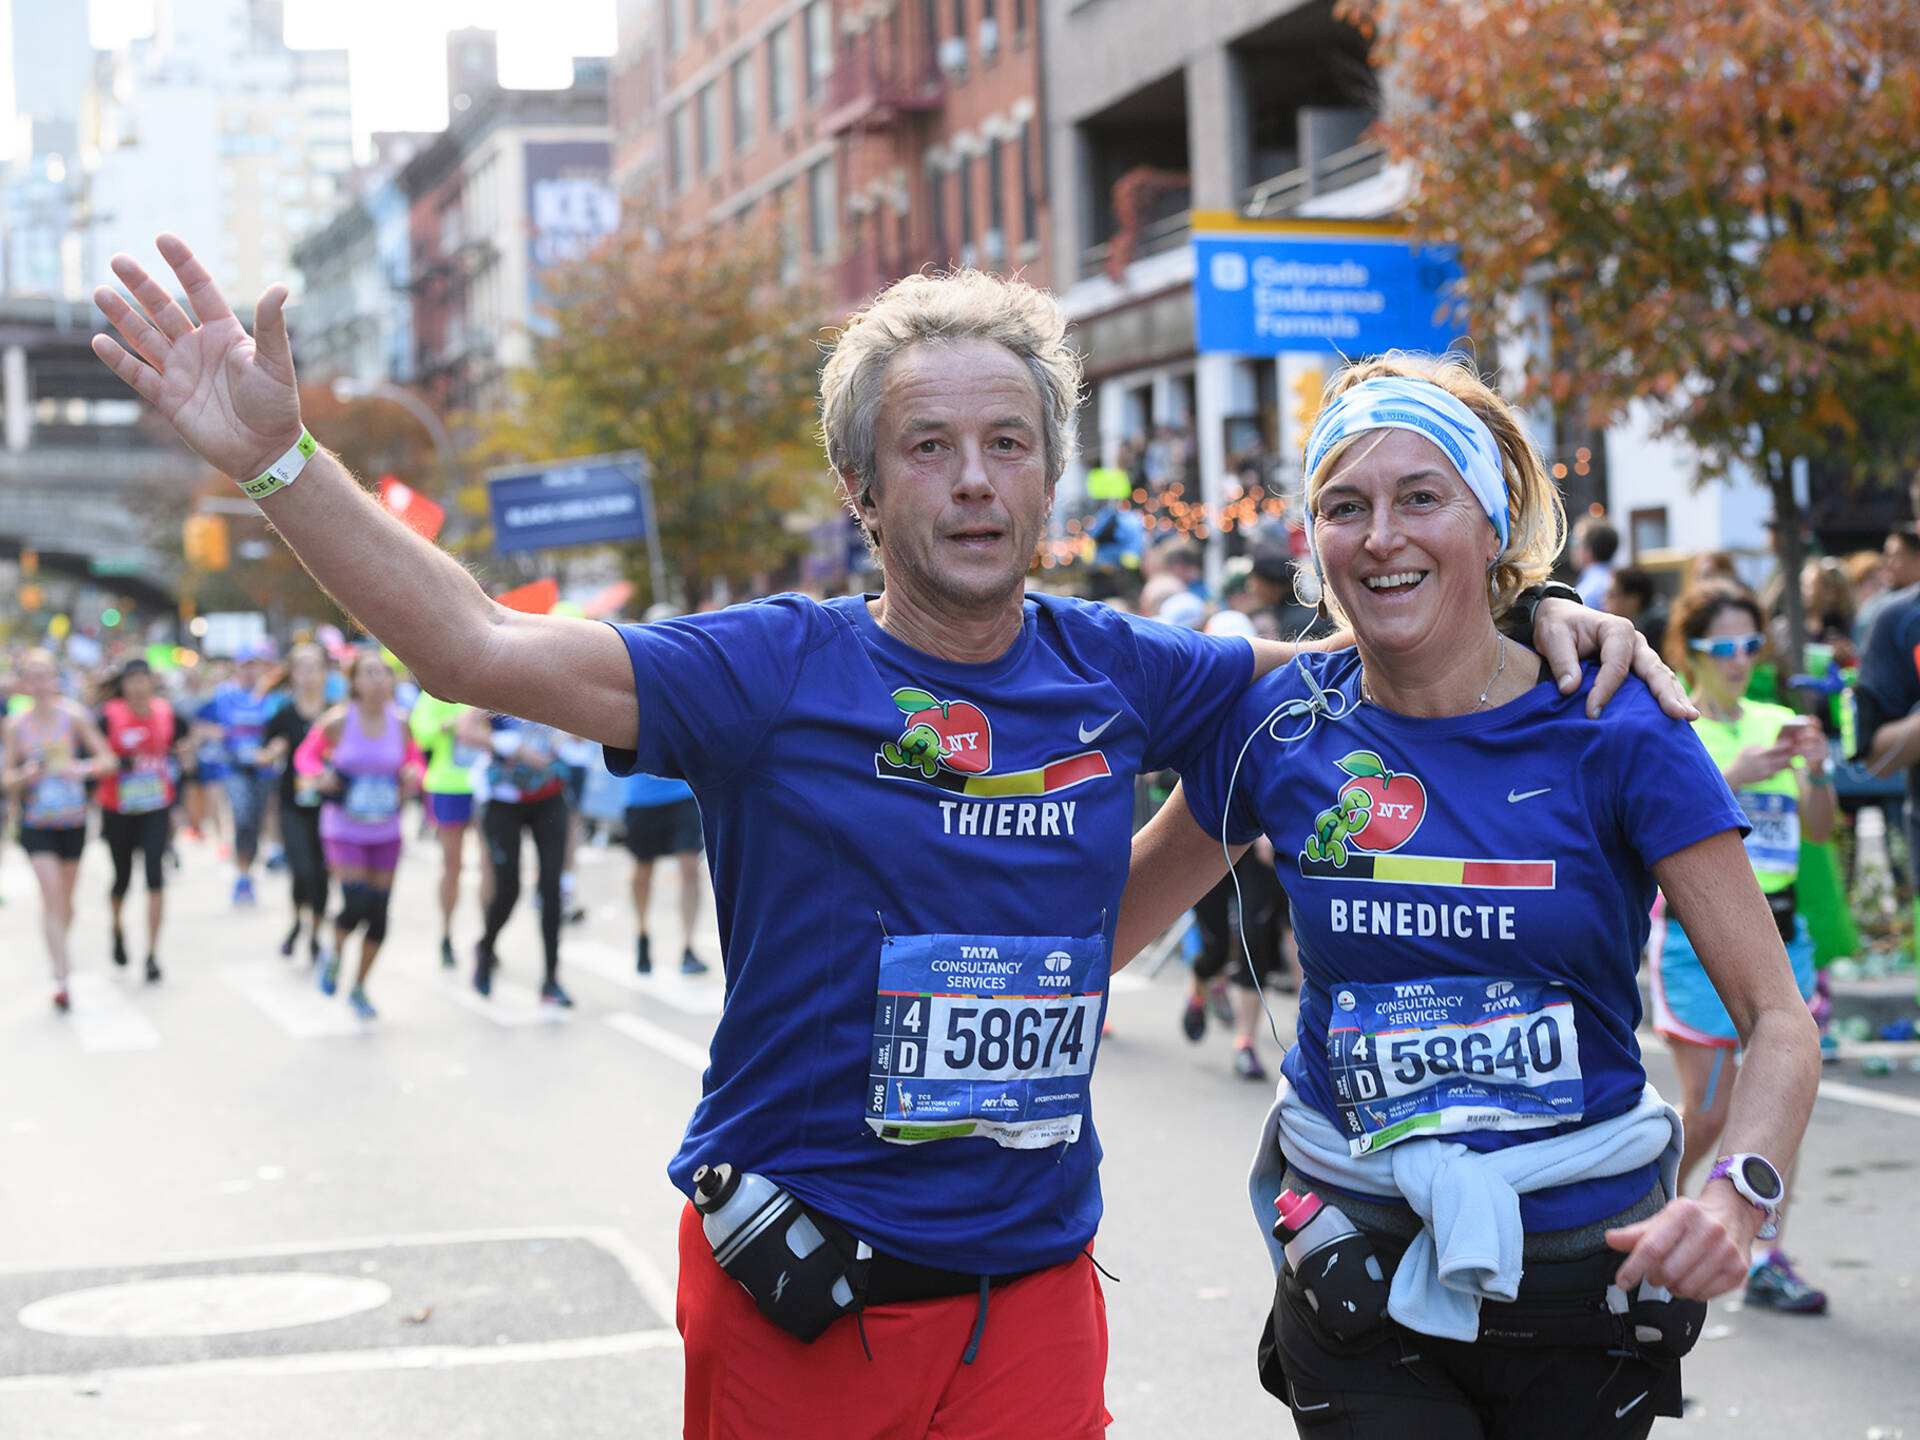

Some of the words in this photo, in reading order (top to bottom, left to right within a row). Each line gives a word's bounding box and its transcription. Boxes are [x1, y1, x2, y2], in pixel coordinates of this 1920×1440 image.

[1253, 256, 1368, 286] Gatorade
[1255, 287, 1385, 312] Endurance
[1255, 312, 1360, 337] Formula
[946, 731, 980, 752] NY
[938, 801, 1076, 836] THIERRY
[1377, 802, 1414, 820] NY
[1330, 899, 1516, 940] BENEDICTE
[960, 946, 998, 960] TATA
[931, 960, 1022, 975] CONSULTANCY
[946, 976, 1006, 989] SERVICES
[1037, 975, 1071, 987] TATA
[1394, 984, 1436, 998] TATA
[903, 1000, 921, 1033] 4
[1375, 995, 1464, 1014] CONSULTANCY
[1389, 1008, 1449, 1025] SERVICES
[1482, 995, 1521, 1013] TATA
[944, 1005, 1086, 1071] 58674
[1352, 1034, 1368, 1061] 4
[1391, 1016, 1562, 1085] 58640
[898, 1041, 919, 1074] D
[1355, 1069, 1377, 1099] D
[873, 1084, 885, 1113] 2016
[1346, 1111, 1361, 1133] 2016
